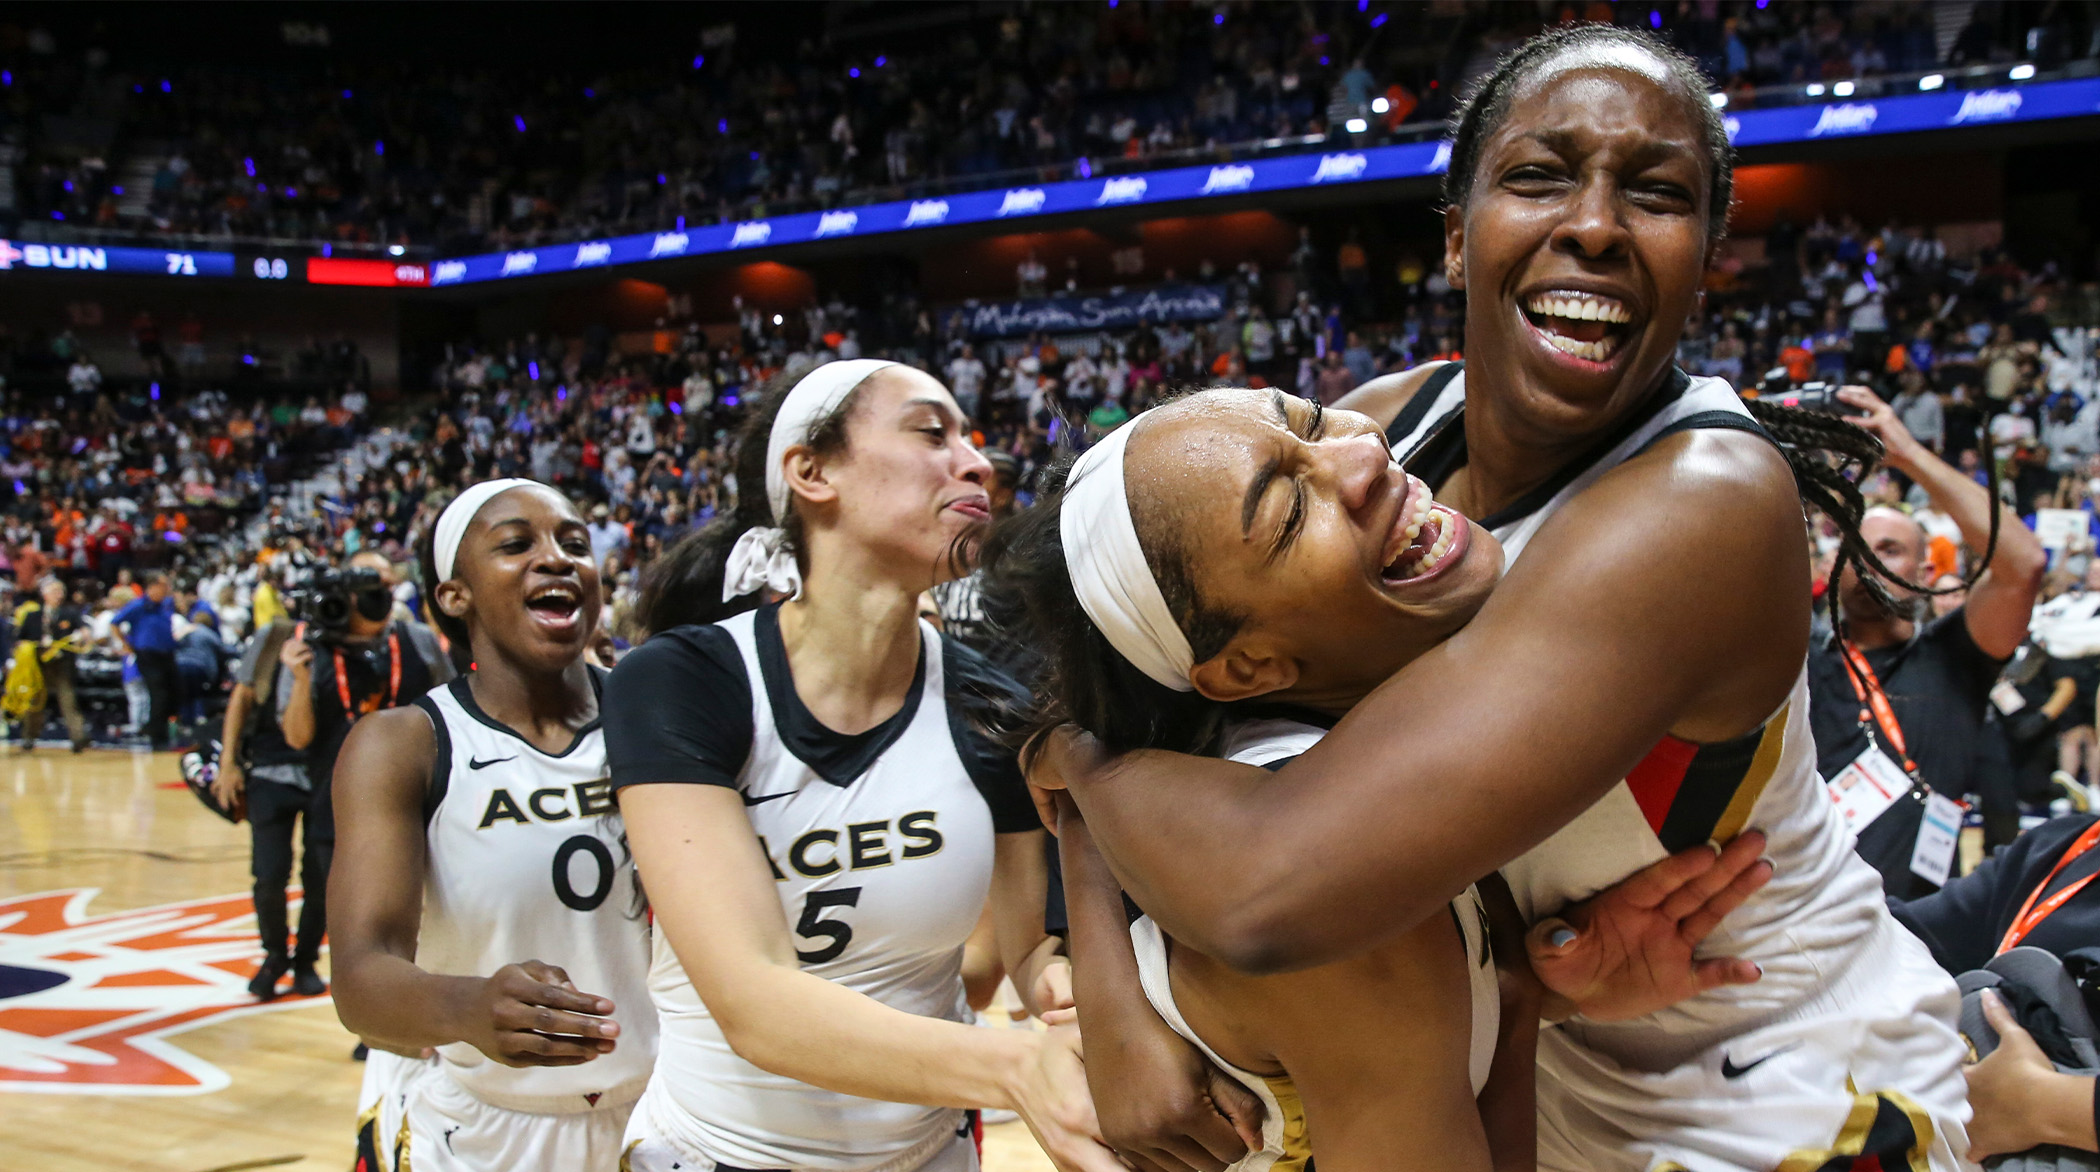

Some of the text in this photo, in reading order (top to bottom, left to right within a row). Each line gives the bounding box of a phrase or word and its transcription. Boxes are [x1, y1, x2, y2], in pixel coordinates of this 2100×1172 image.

[23, 244, 108, 270] SUN
[165, 253, 197, 275] 71
[253, 257, 288, 279] 0.0
[477, 777, 618, 830] ACE
[552, 834, 615, 912] 0
[795, 886, 863, 964] 5
